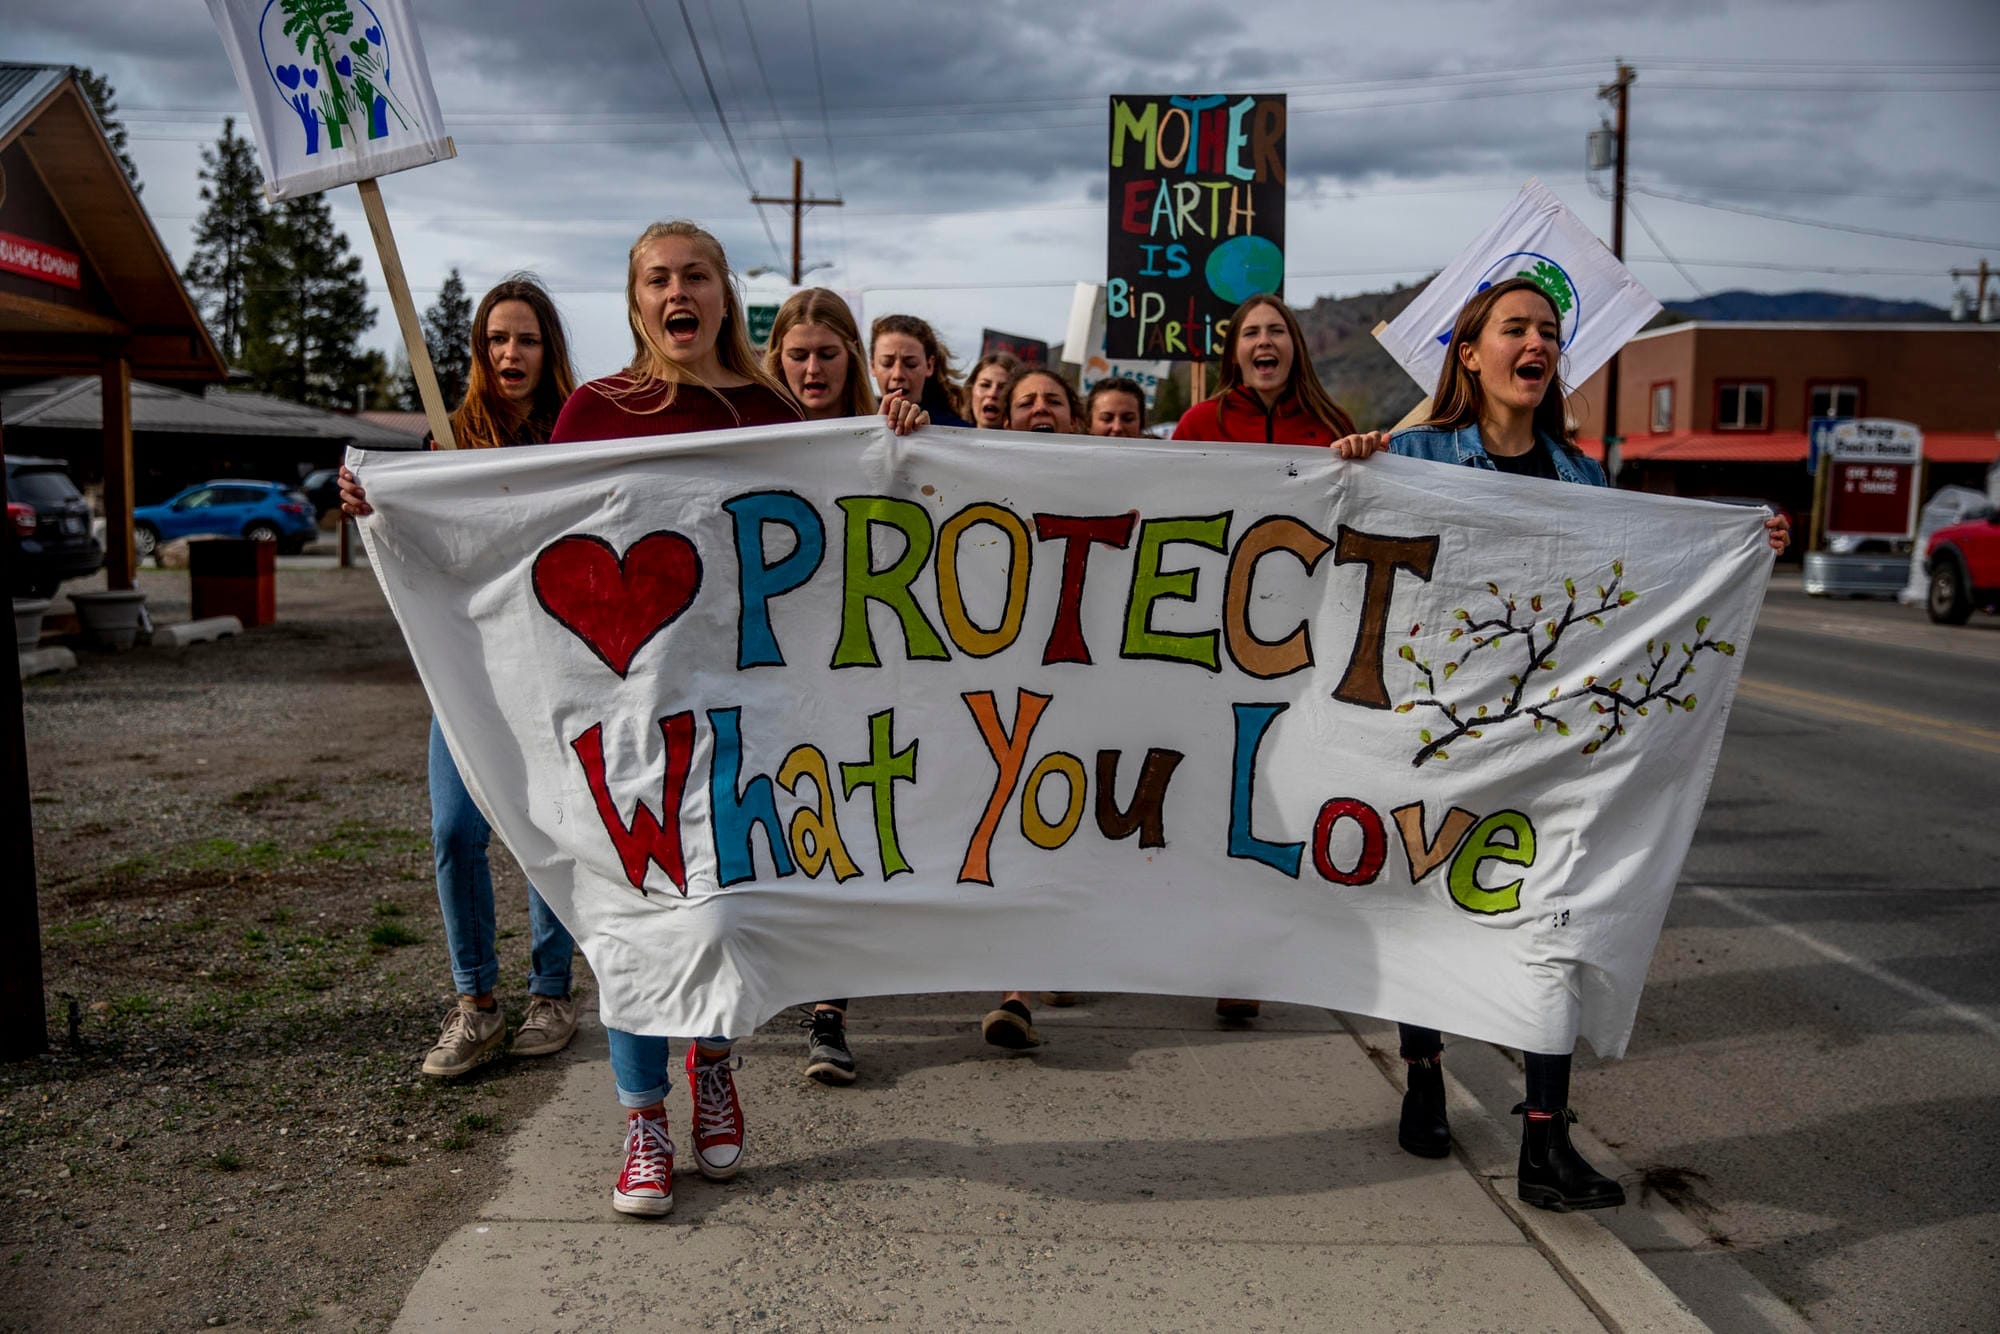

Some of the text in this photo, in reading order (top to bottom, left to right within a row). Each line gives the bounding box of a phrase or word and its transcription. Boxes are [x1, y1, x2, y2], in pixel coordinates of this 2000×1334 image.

[1112, 94, 1285, 186] MOTHER
[1121, 178, 1256, 240] EARTH
[1138, 243, 1192, 279] IS
[722, 490, 1440, 710] PROTECT
[570, 687, 1536, 915] What You Love
